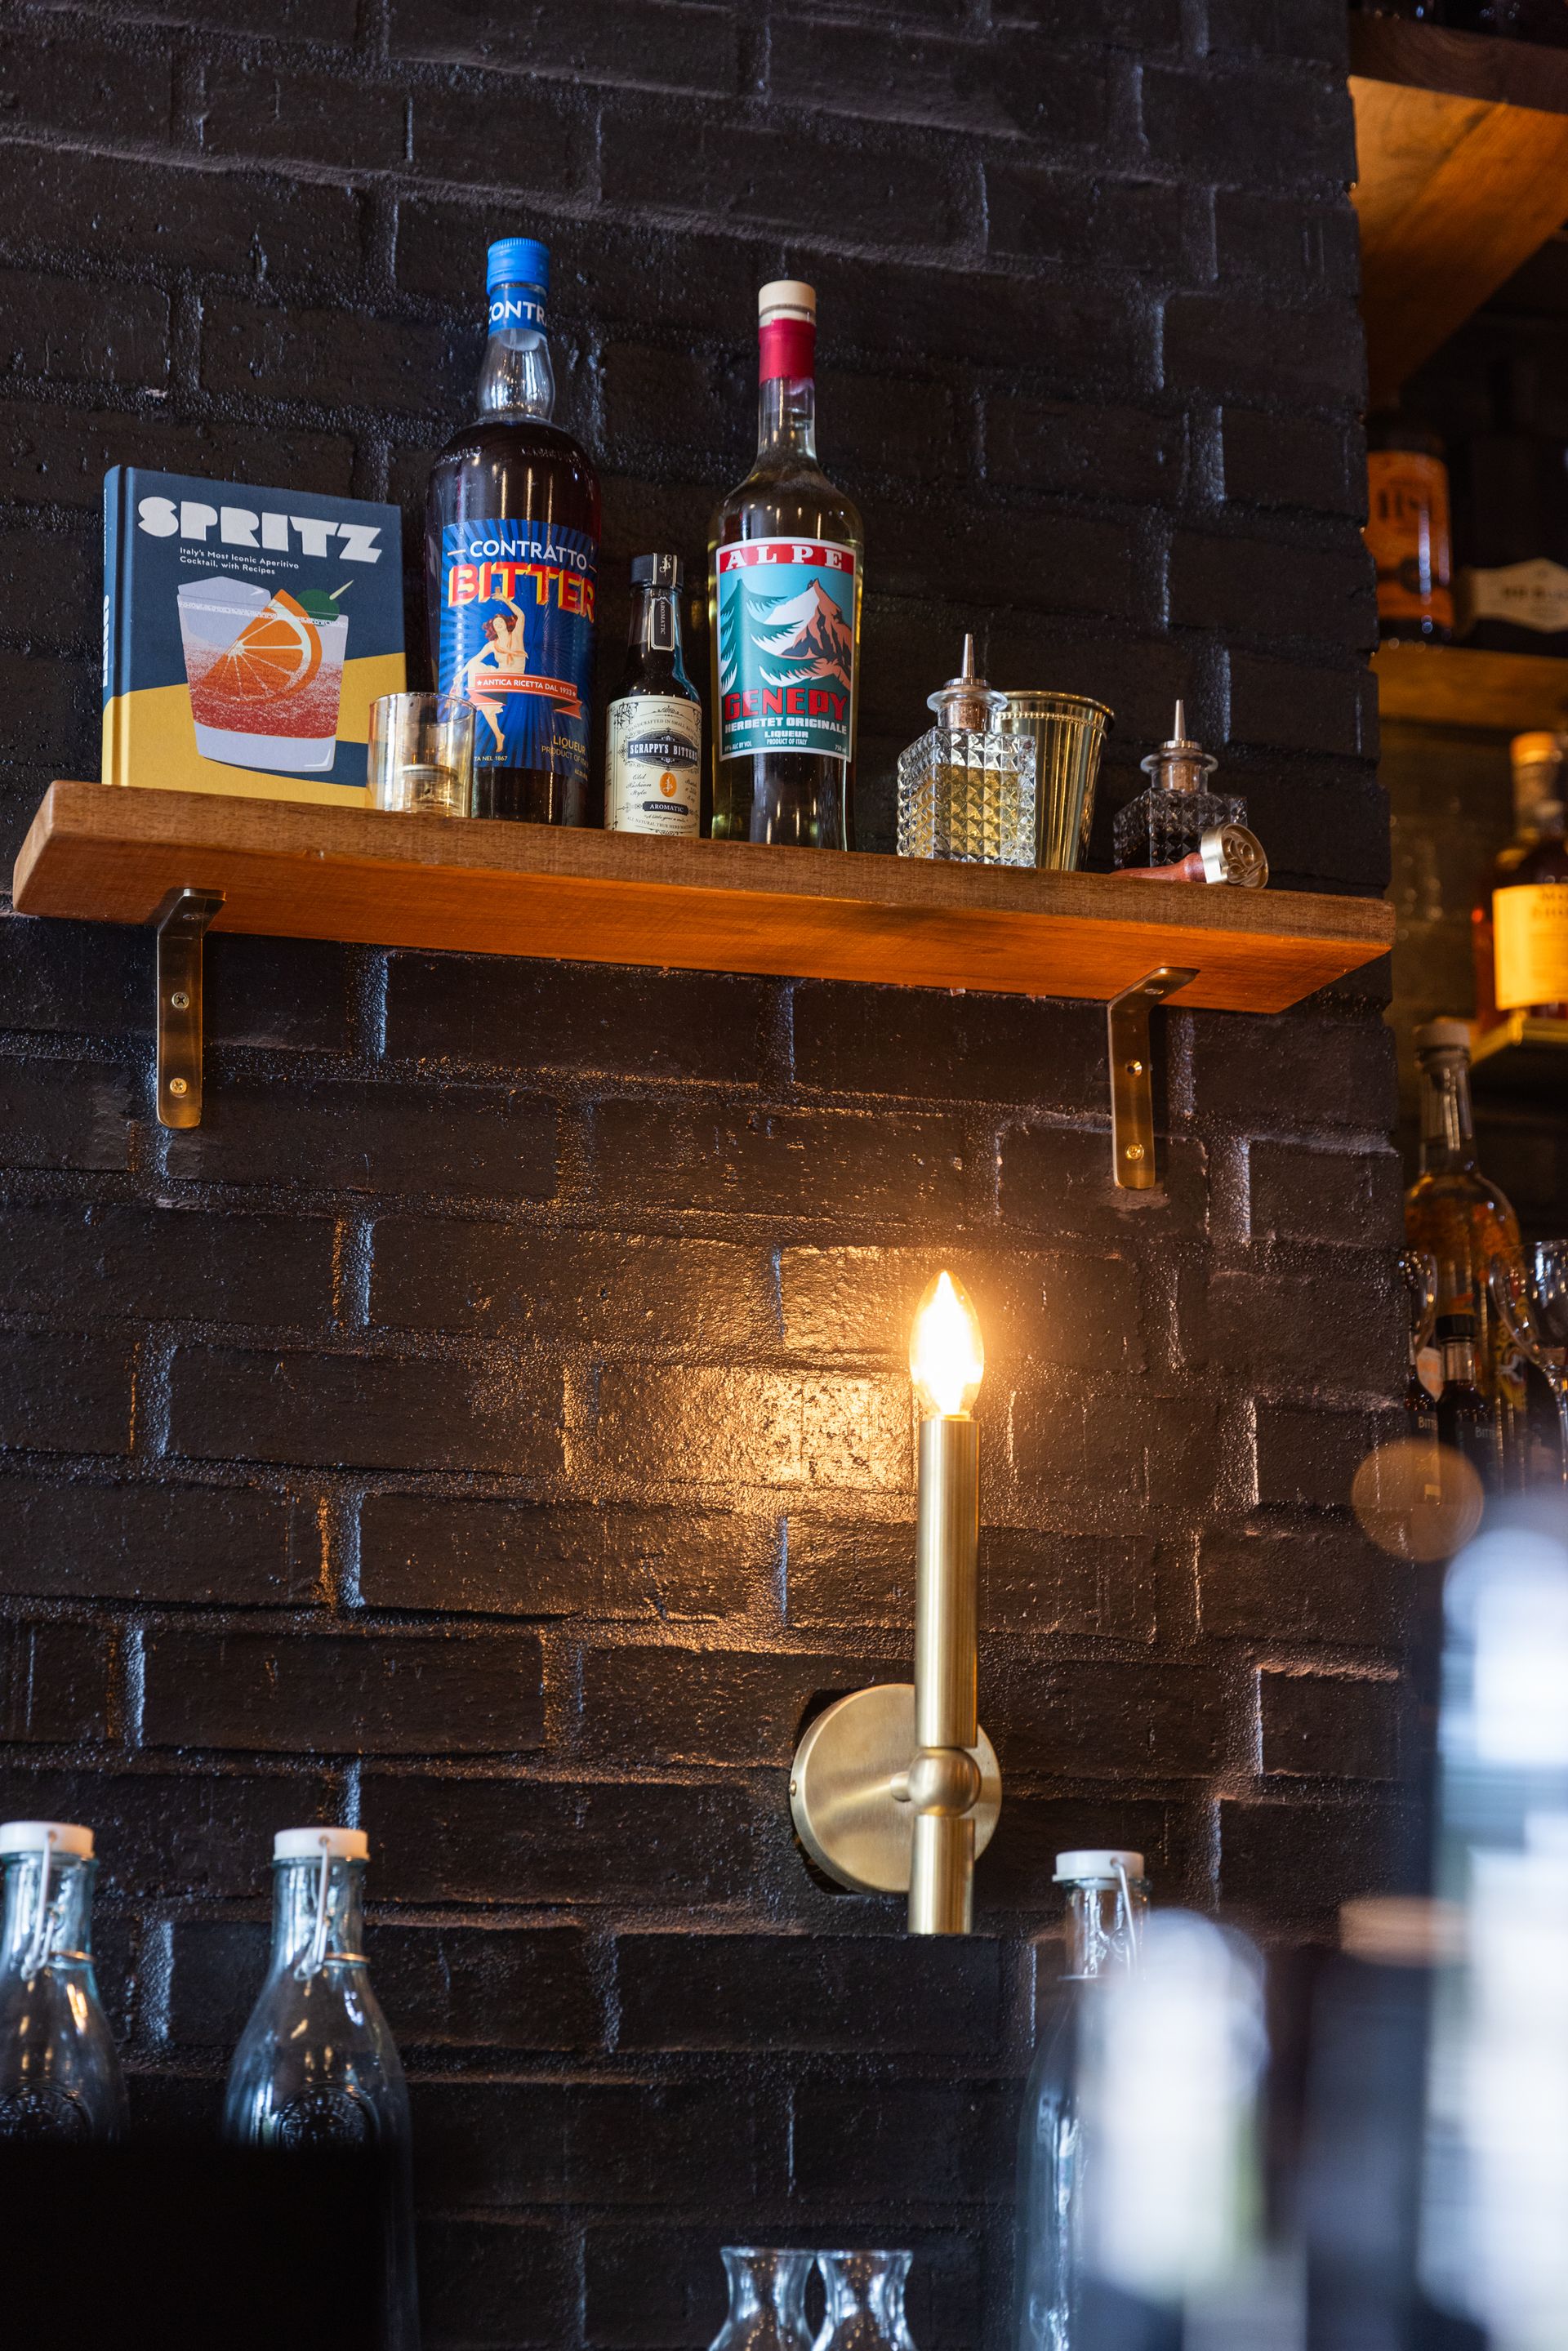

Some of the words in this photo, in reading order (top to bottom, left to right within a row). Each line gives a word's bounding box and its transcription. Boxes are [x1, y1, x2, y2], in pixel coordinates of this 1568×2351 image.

[137, 496, 383, 563] SPRITZ
[180, 546, 204, 557] Italy's
[207, 550, 229, 560] Most
[231, 554, 256, 563] Iconic
[259, 558, 299, 570] Aperitivo
[470, 540, 586, 570] CONTRATTO
[725, 545, 842, 571] ALPE
[180, 556, 218, 568] Cocktail,
[221, 562, 239, 570] with
[242, 563, 275, 575] Recipes
[448, 561, 595, 624] BITTER
[483, 679, 512, 687] ANTICA
[514, 680, 543, 689] RICETTA
[545, 683, 559, 692] DAL
[559, 687, 572, 697] 1933
[724, 687, 848, 721] GENEPY
[724, 717, 784, 733] HERBETET
[786, 717, 847, 735] ORIGINALE
[764, 729, 809, 738] LIQUEUR
[553, 735, 586, 755] LIQUEUR
[766, 737, 788, 746] PRODUCT
[541, 746, 572, 759] PRODUCT
[573, 754, 581, 763] OF
[630, 743, 669, 755] SCRAPPY'S
[673, 745, 697, 761] BITTERS
[649, 804, 684, 813] AROMATIC
